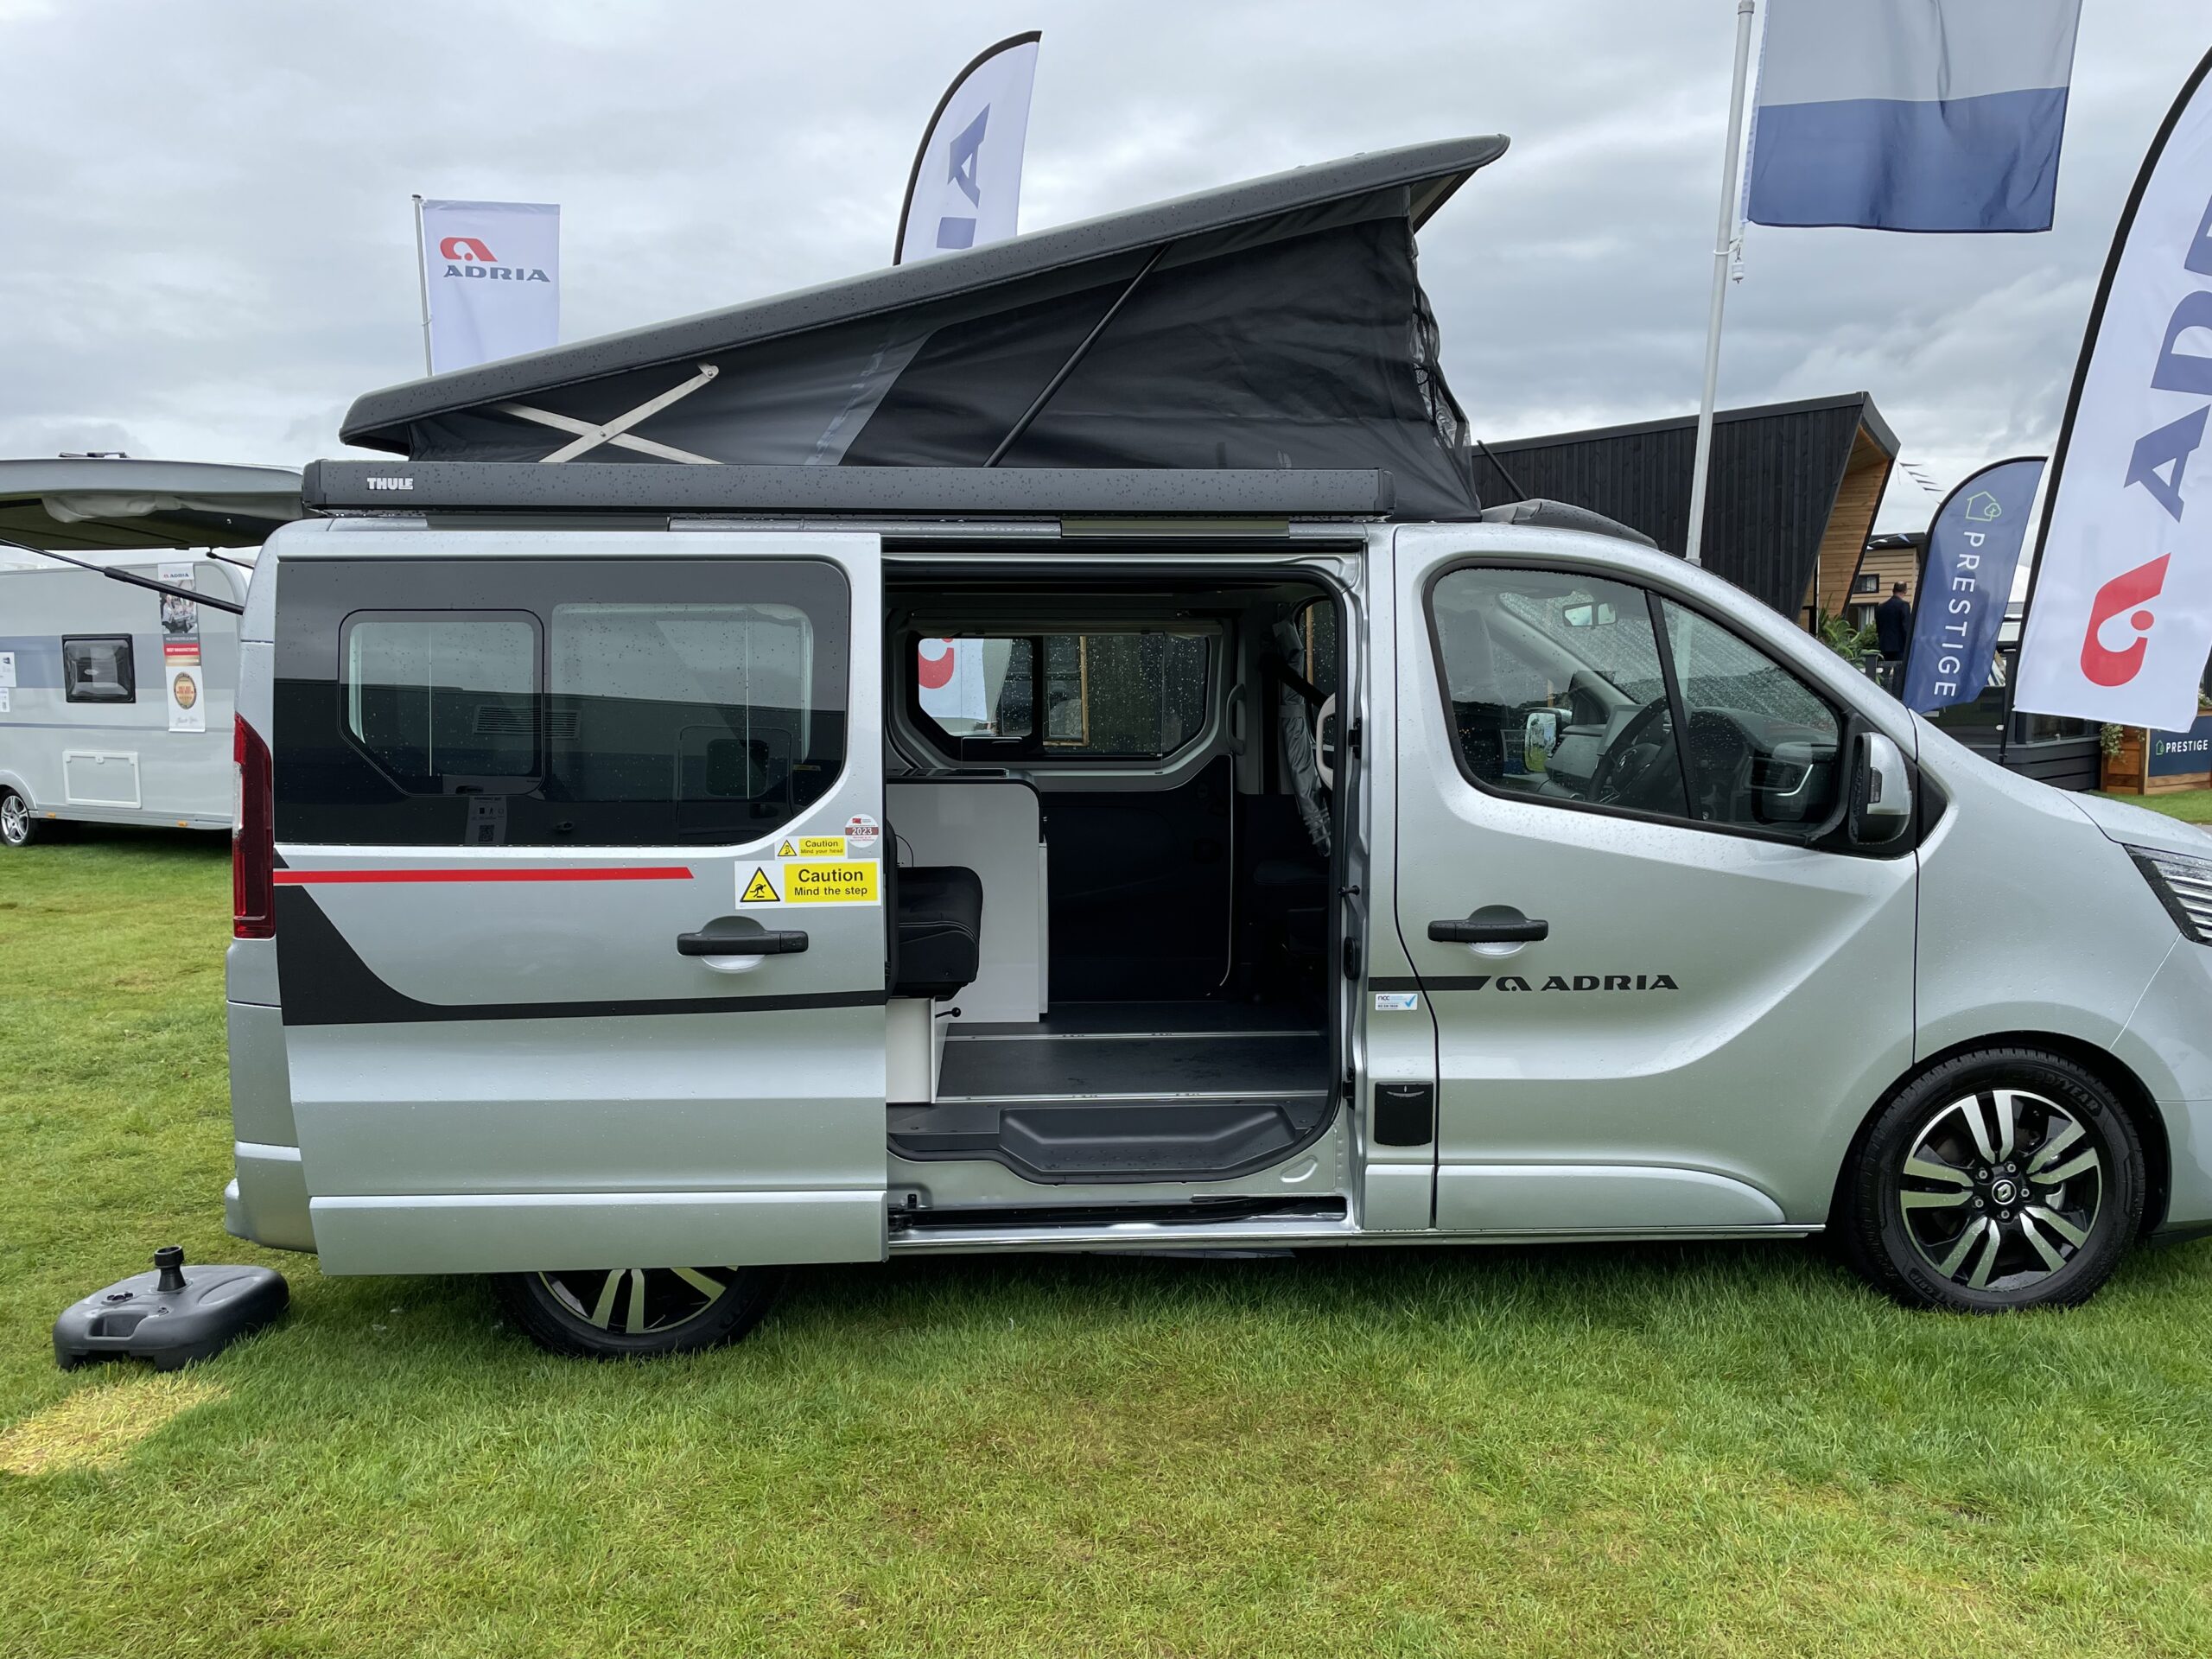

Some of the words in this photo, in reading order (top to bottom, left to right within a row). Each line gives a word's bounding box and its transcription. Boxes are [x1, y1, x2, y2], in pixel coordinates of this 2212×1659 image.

[443, 264, 551, 283] ADRIA
[366, 477, 414, 490] THULE
[1934, 531, 1986, 697] PRESTIGE
[2165, 739, 2209, 753] PRESTIGE
[852, 827, 873, 836] 2023
[798, 868, 864, 883] Caution
[794, 887, 820, 896] Mind
[823, 887, 842, 896] the
[844, 886, 868, 897] step
[1540, 974, 1680, 991] ADRIA
